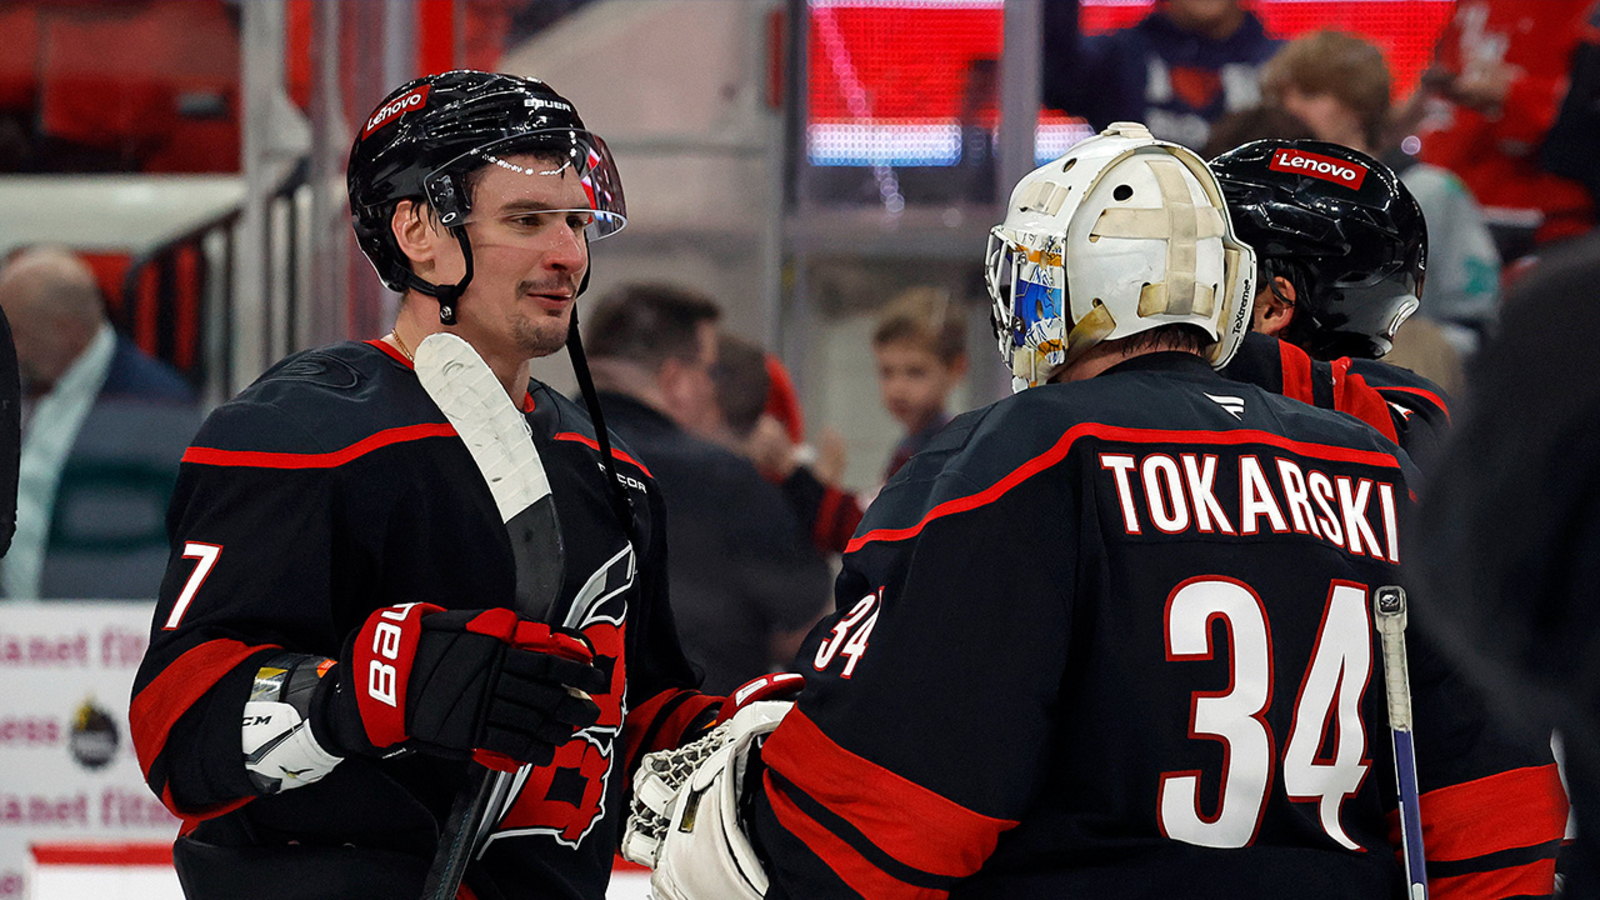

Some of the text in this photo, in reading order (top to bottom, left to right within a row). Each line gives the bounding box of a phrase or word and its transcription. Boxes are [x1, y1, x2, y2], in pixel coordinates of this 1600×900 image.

[366, 93, 422, 131] Lenovo
[1278, 152, 1356, 181] Lenovo
[597, 462, 648, 494] COR
[1100, 453, 1401, 564] TOKARSKI
[161, 540, 224, 631] 7
[813, 585, 886, 679] 34
[241, 715, 273, 727] CM
[1156, 574, 1374, 852] 34
